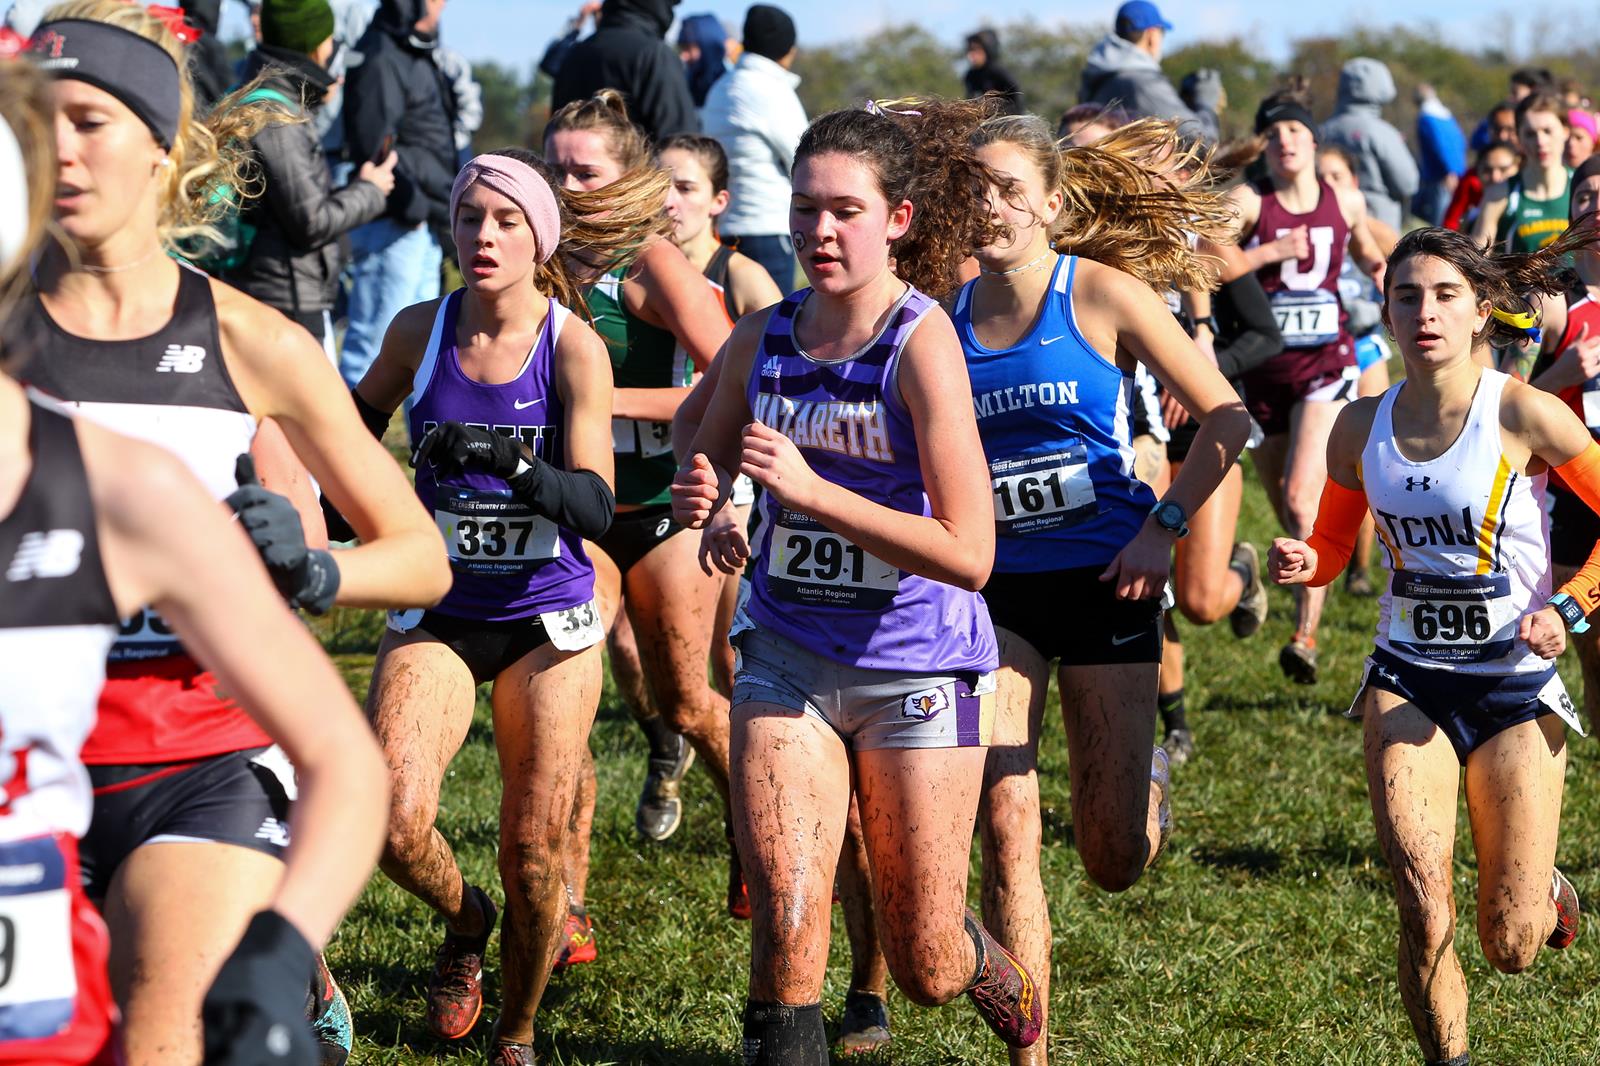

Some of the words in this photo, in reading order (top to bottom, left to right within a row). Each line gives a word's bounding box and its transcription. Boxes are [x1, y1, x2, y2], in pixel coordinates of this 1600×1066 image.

[1276, 226, 1334, 292] U
[1277, 310, 1321, 331] 717
[754, 392, 896, 464] NAZARETH
[992, 462, 1008, 471] CROSS
[1008, 459, 1030, 468] COUNTRY
[1031, 453, 1071, 465] CHAMPIONSHIPS
[993, 472, 1066, 517] 161
[457, 501, 475, 510] CROSS
[789, 512, 808, 522] CROSS
[1012, 520, 1035, 529] Atlantic
[1036, 514, 1064, 527] Regional
[1376, 505, 1478, 551] TCNJ
[456, 520, 533, 557] 337
[494, 563, 523, 571] Regional
[786, 534, 864, 583] 291
[797, 586, 823, 596] Atlantic
[824, 589, 857, 600] Regional
[1413, 586, 1430, 594] CROSS
[1429, 587, 1452, 595] COUNTRY
[1453, 585, 1496, 595] CHAMPIONSHIPS
[1412, 603, 1491, 641] 696
[1451, 648, 1481, 656] Regional
